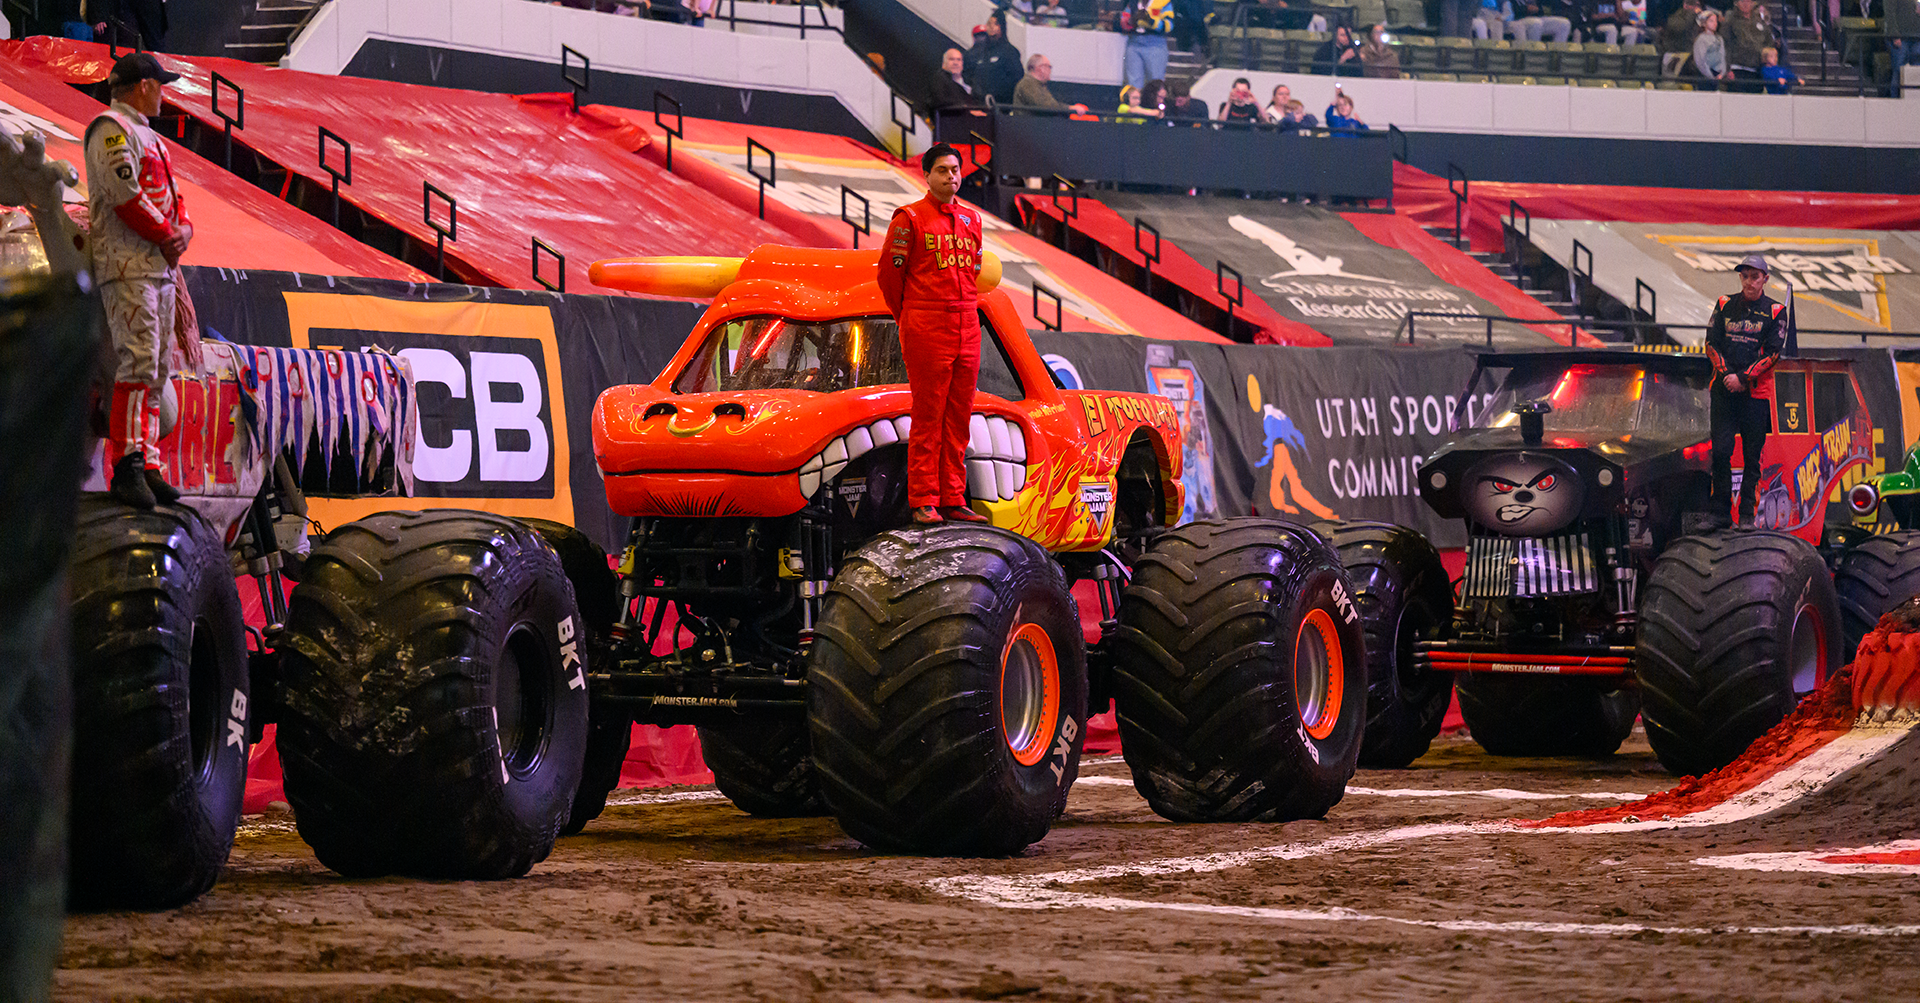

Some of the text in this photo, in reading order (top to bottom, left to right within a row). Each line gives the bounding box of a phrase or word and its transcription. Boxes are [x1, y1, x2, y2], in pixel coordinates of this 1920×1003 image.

[1674, 252, 1911, 274] MOSTER
[1287, 296, 1398, 320] Research
[361, 346, 549, 483] CB
[1315, 397, 1379, 438] UTAH
[839, 485, 867, 495] MONSTER
[847, 494, 861, 502] JAM
[1080, 491, 1114, 503] MONSTER
[1089, 502, 1107, 513] JAM
[1330, 578, 1358, 625] BKT
[557, 614, 586, 692] BKT
[1050, 714, 1078, 787] BKT
